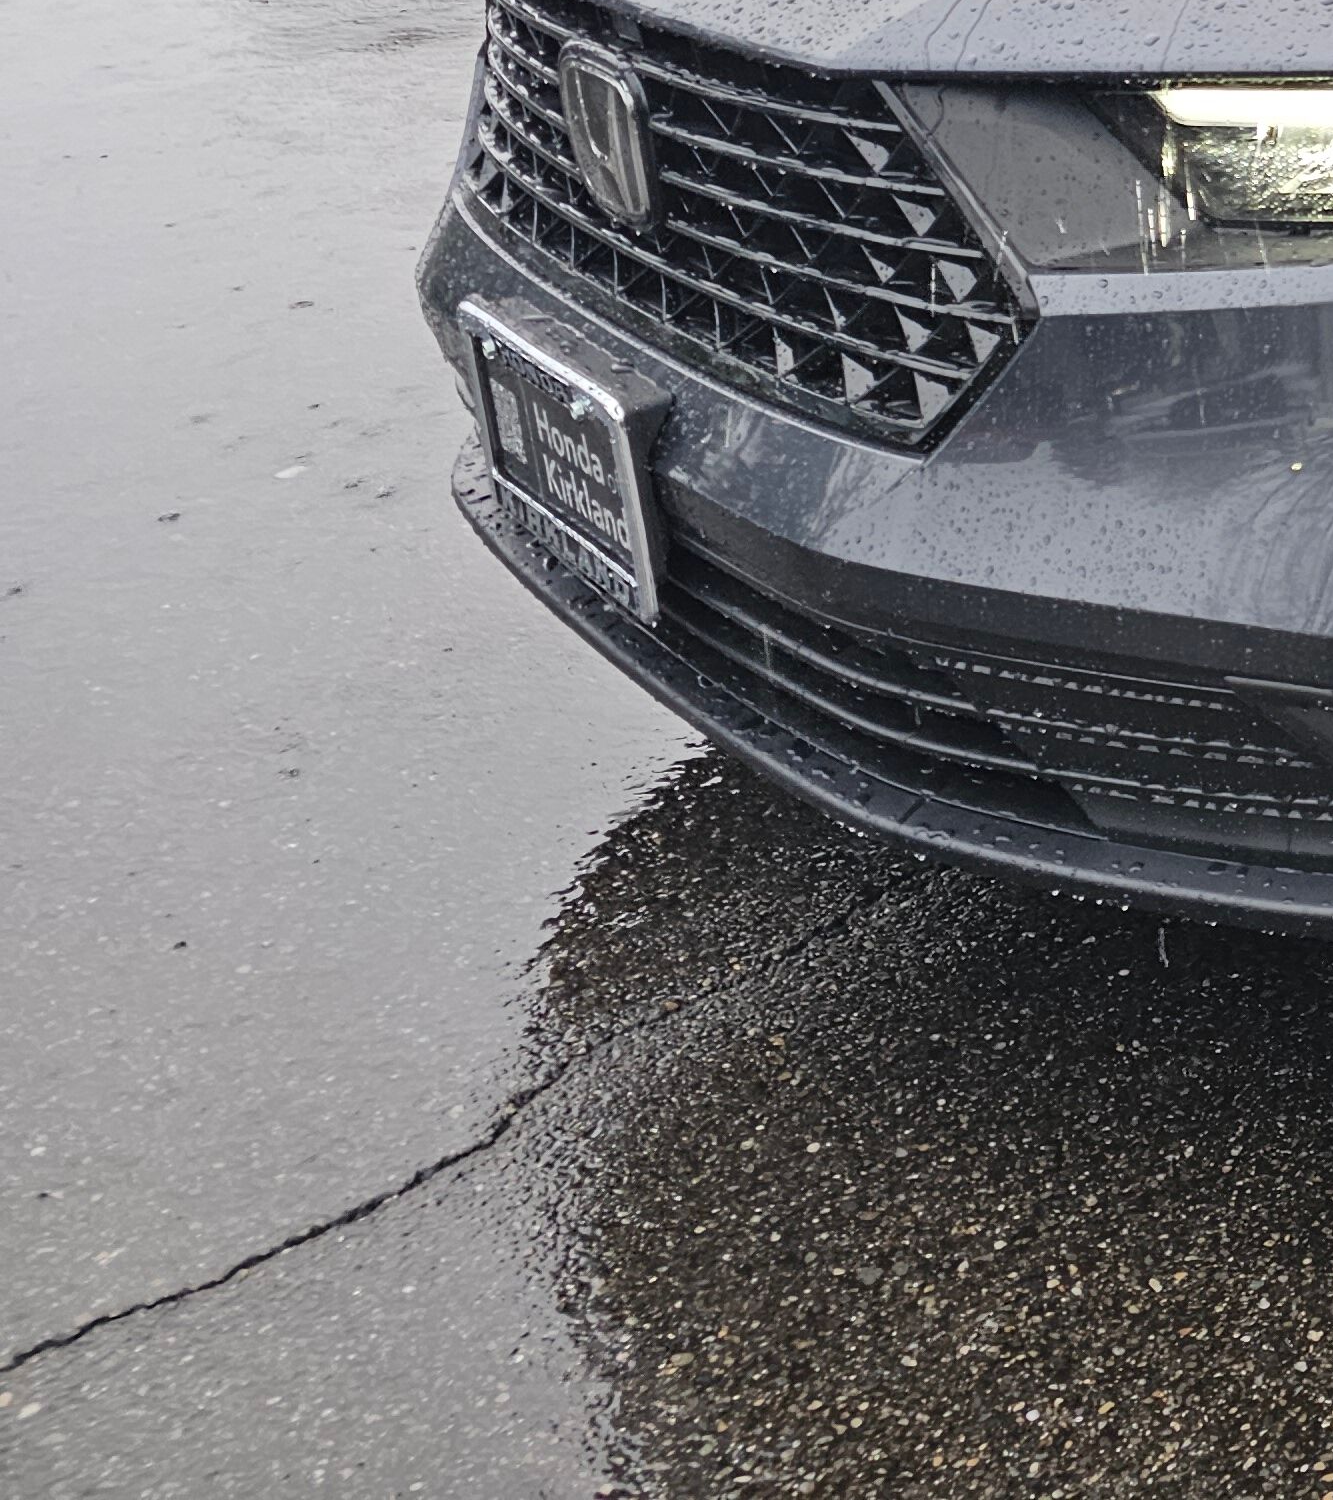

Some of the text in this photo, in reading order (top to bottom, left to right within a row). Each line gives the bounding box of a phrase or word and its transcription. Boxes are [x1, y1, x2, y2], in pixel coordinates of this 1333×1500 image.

[533, 402, 606, 487] Honda
[501, 483, 630, 606] KIRKLAND
[545, 454, 631, 549] Kirkland
